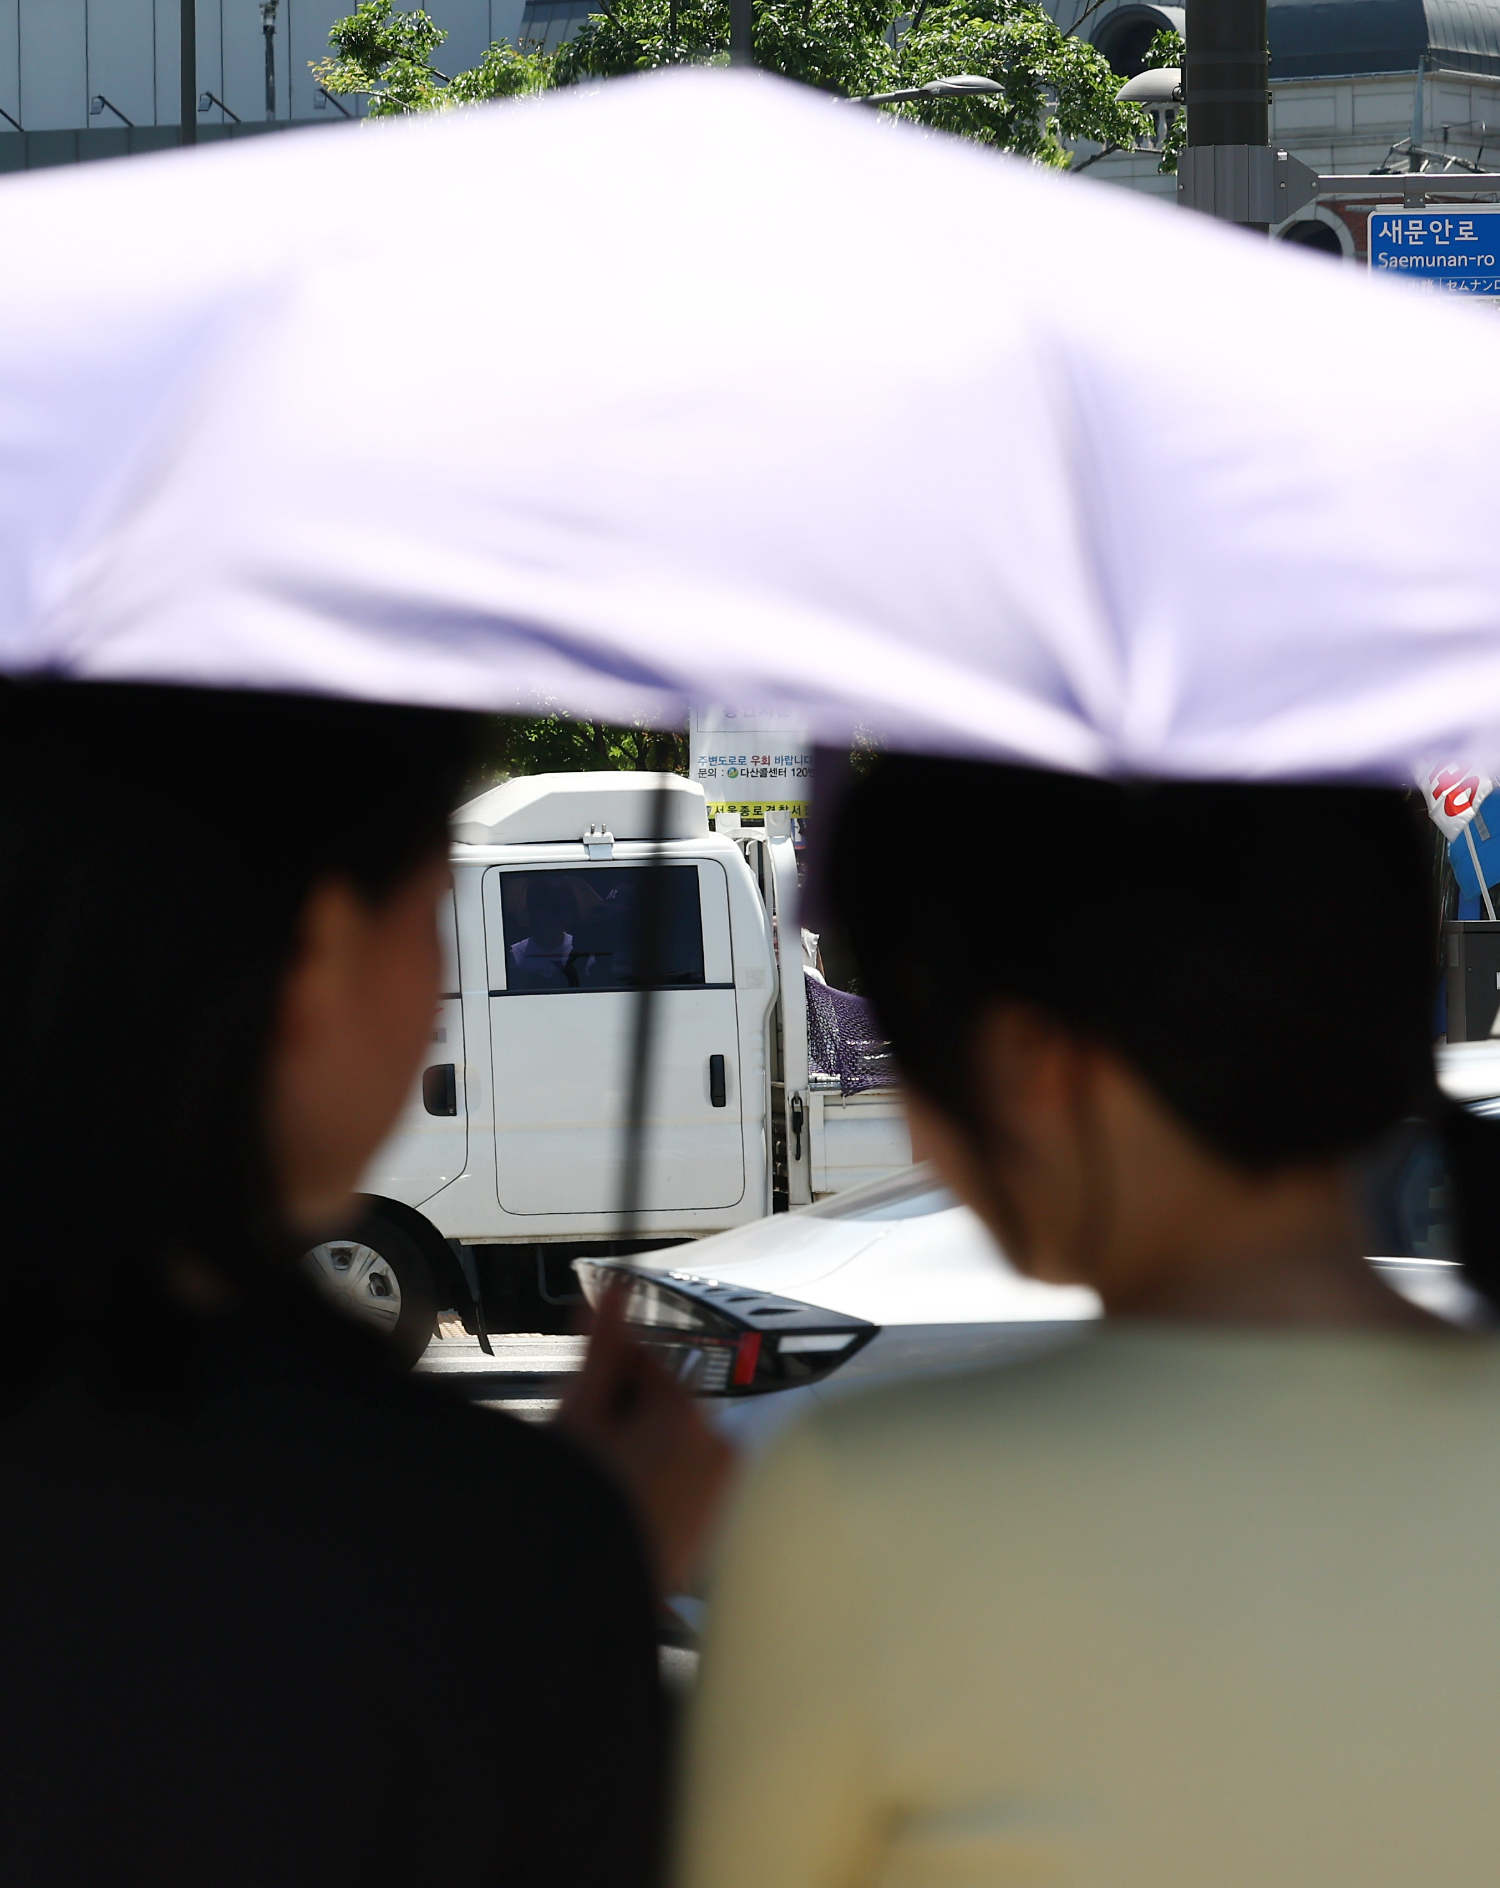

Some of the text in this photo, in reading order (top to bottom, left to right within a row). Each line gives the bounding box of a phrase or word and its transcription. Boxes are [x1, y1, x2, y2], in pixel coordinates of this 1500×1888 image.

[1378, 219, 1479, 245] 새문안로
[1378, 252, 1495, 269] Saemunan-ro
[698, 755, 747, 767] 주변도로로
[750, 755, 771, 767] 우회
[697, 768, 717, 779] 문의
[740, 767, 787, 778] 다산콜센터
